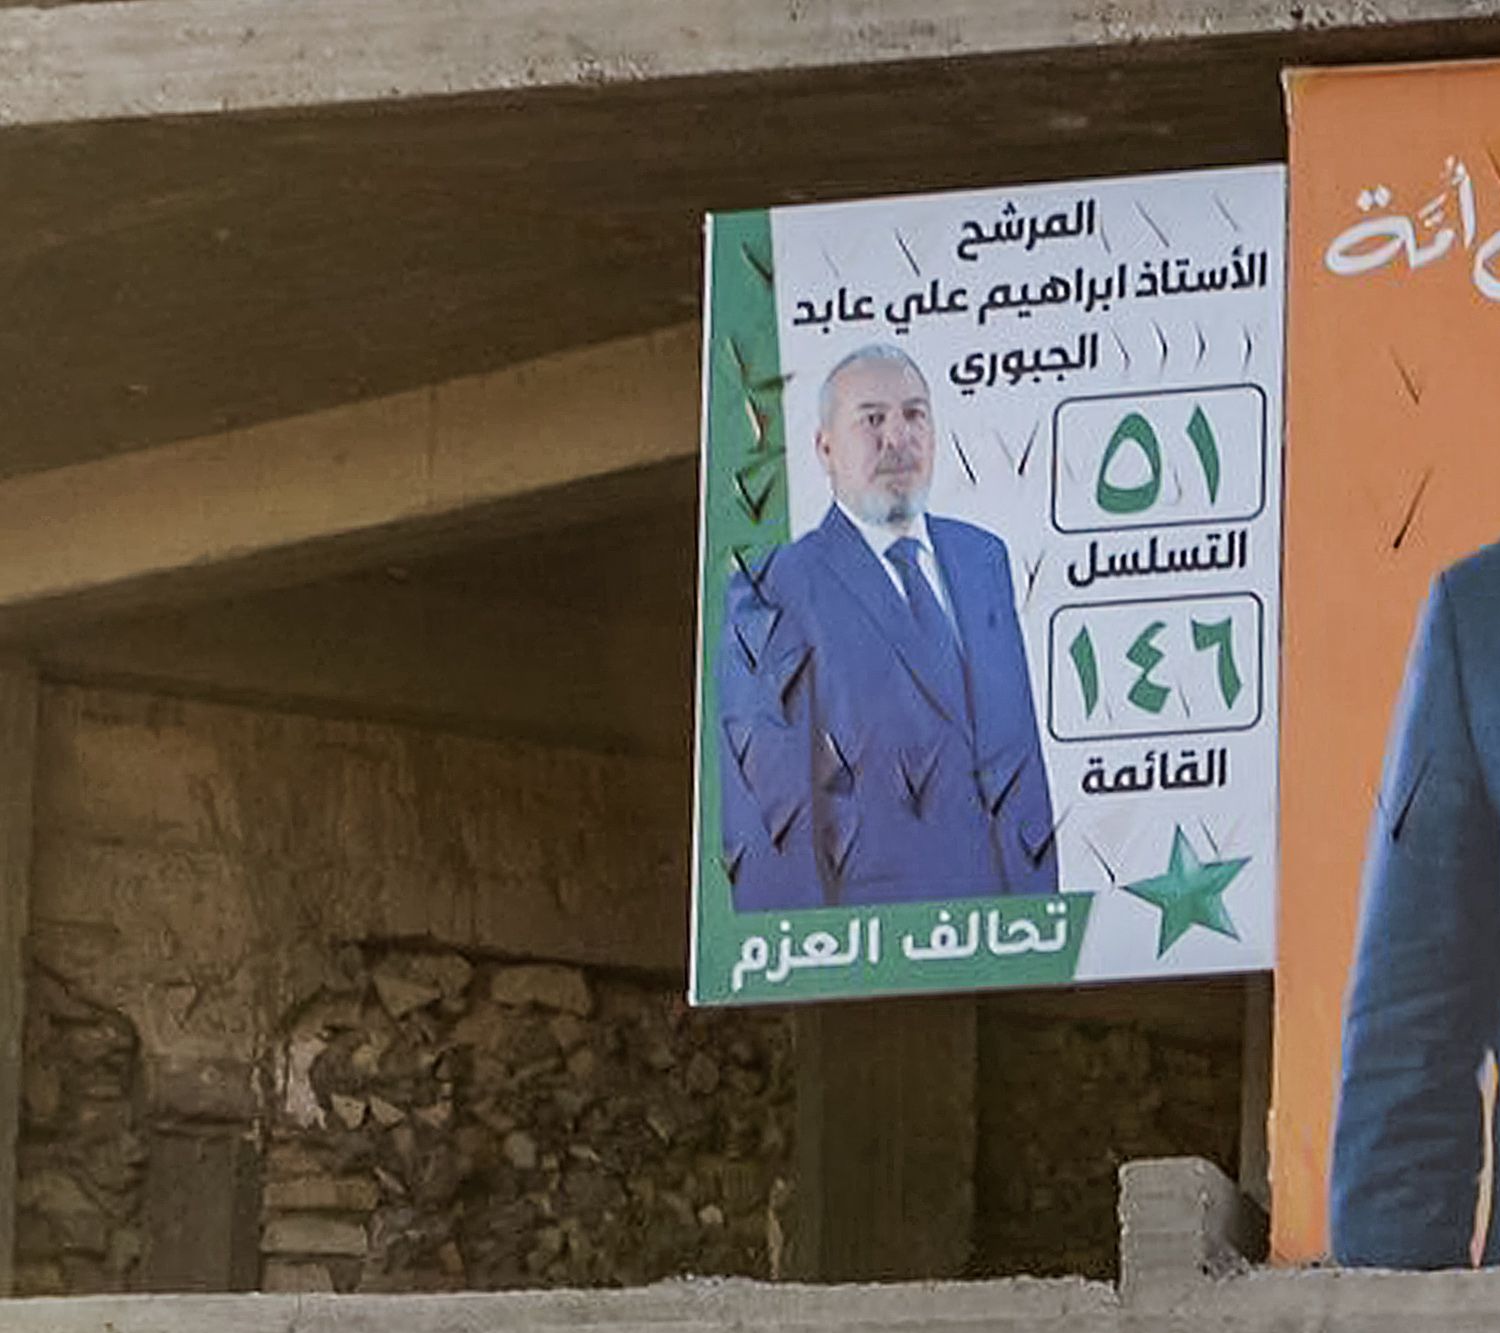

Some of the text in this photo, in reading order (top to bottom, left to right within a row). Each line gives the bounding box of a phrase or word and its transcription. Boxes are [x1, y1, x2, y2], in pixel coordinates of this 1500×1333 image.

[957, 199, 1095, 260] المرشح
[792, 245, 1267, 335] الأستاذ ابراهيم علي عابد
[949, 334, 1098, 396] الجبوري
[1095, 402, 1222, 515] ٥١
[1067, 530, 1248, 588] التسلسل
[1070, 615, 1243, 720] ١٤٦
[1082, 748, 1229, 796] القائمة
[733, 905, 1068, 992] تحالف العزم
